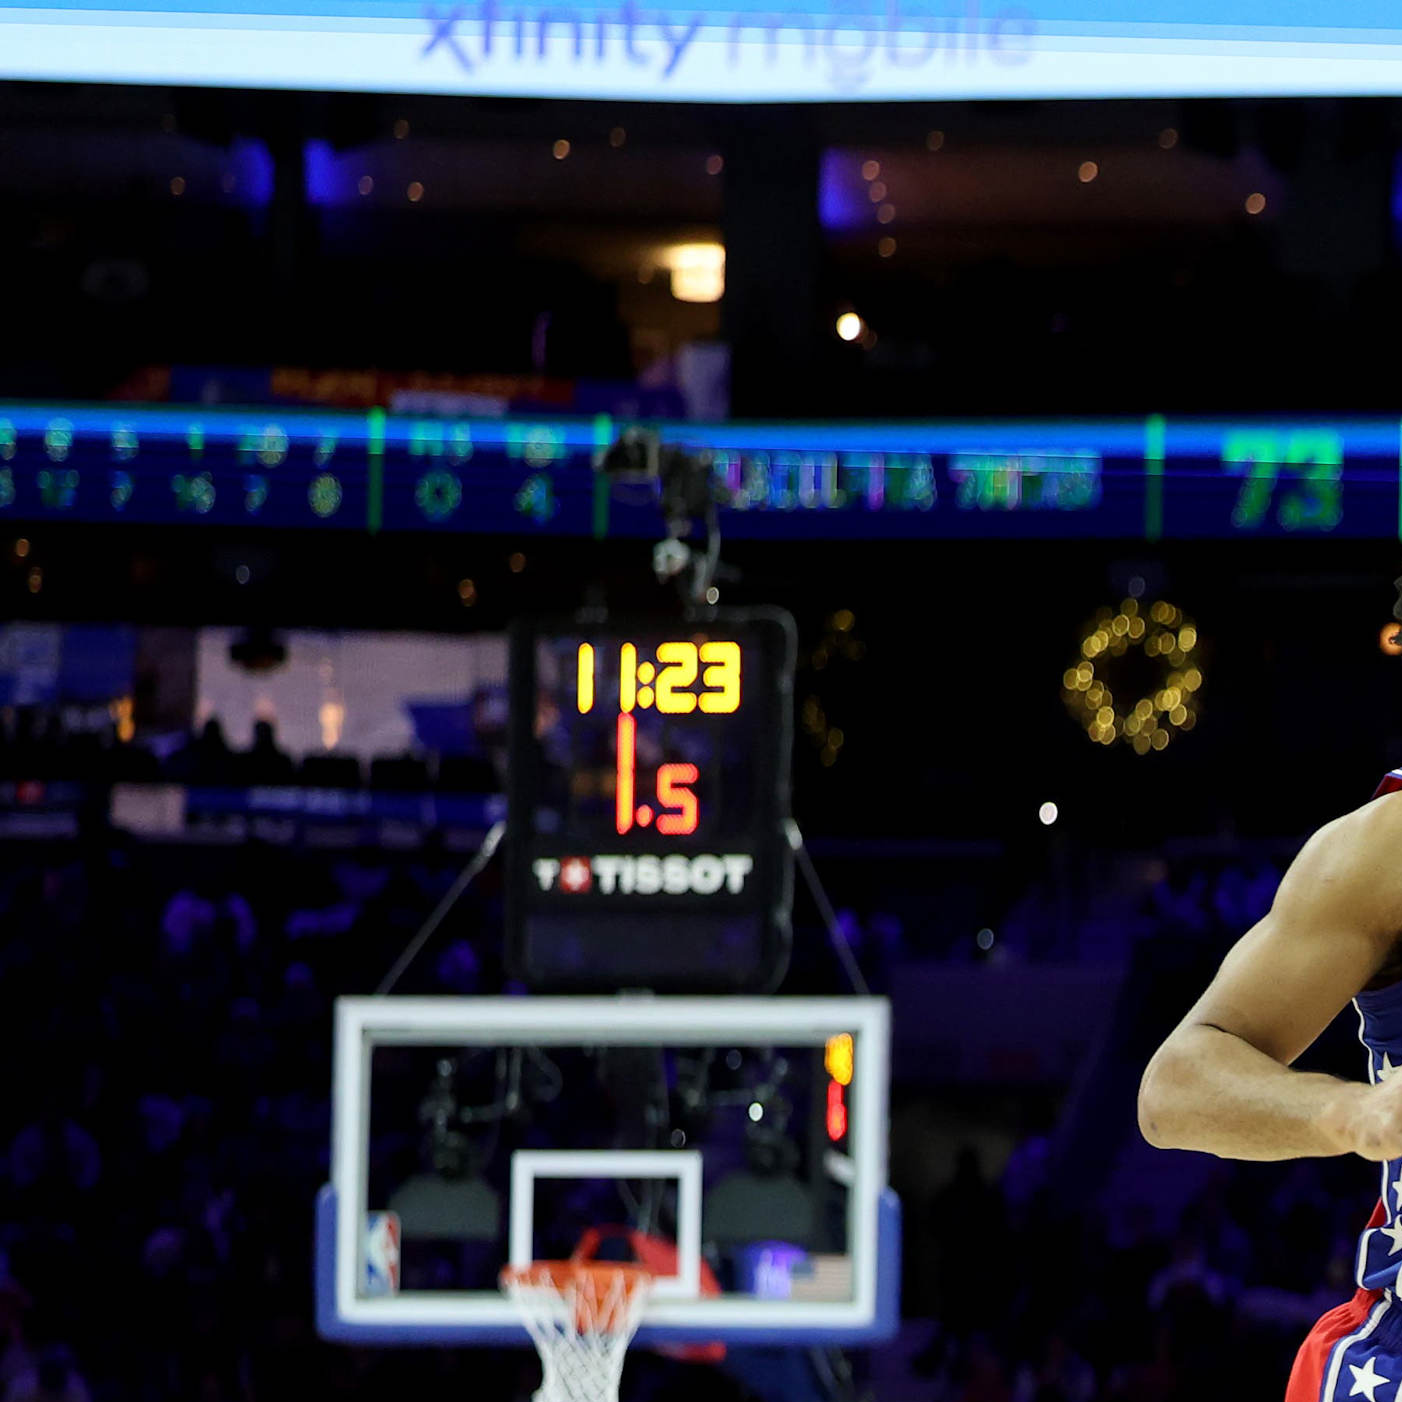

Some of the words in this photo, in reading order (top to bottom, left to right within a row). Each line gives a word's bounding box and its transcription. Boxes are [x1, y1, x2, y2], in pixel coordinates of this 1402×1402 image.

[577, 641, 741, 714] 11:23
[616, 711, 699, 835] 1.5
[592, 855, 753, 894] TISSOT
